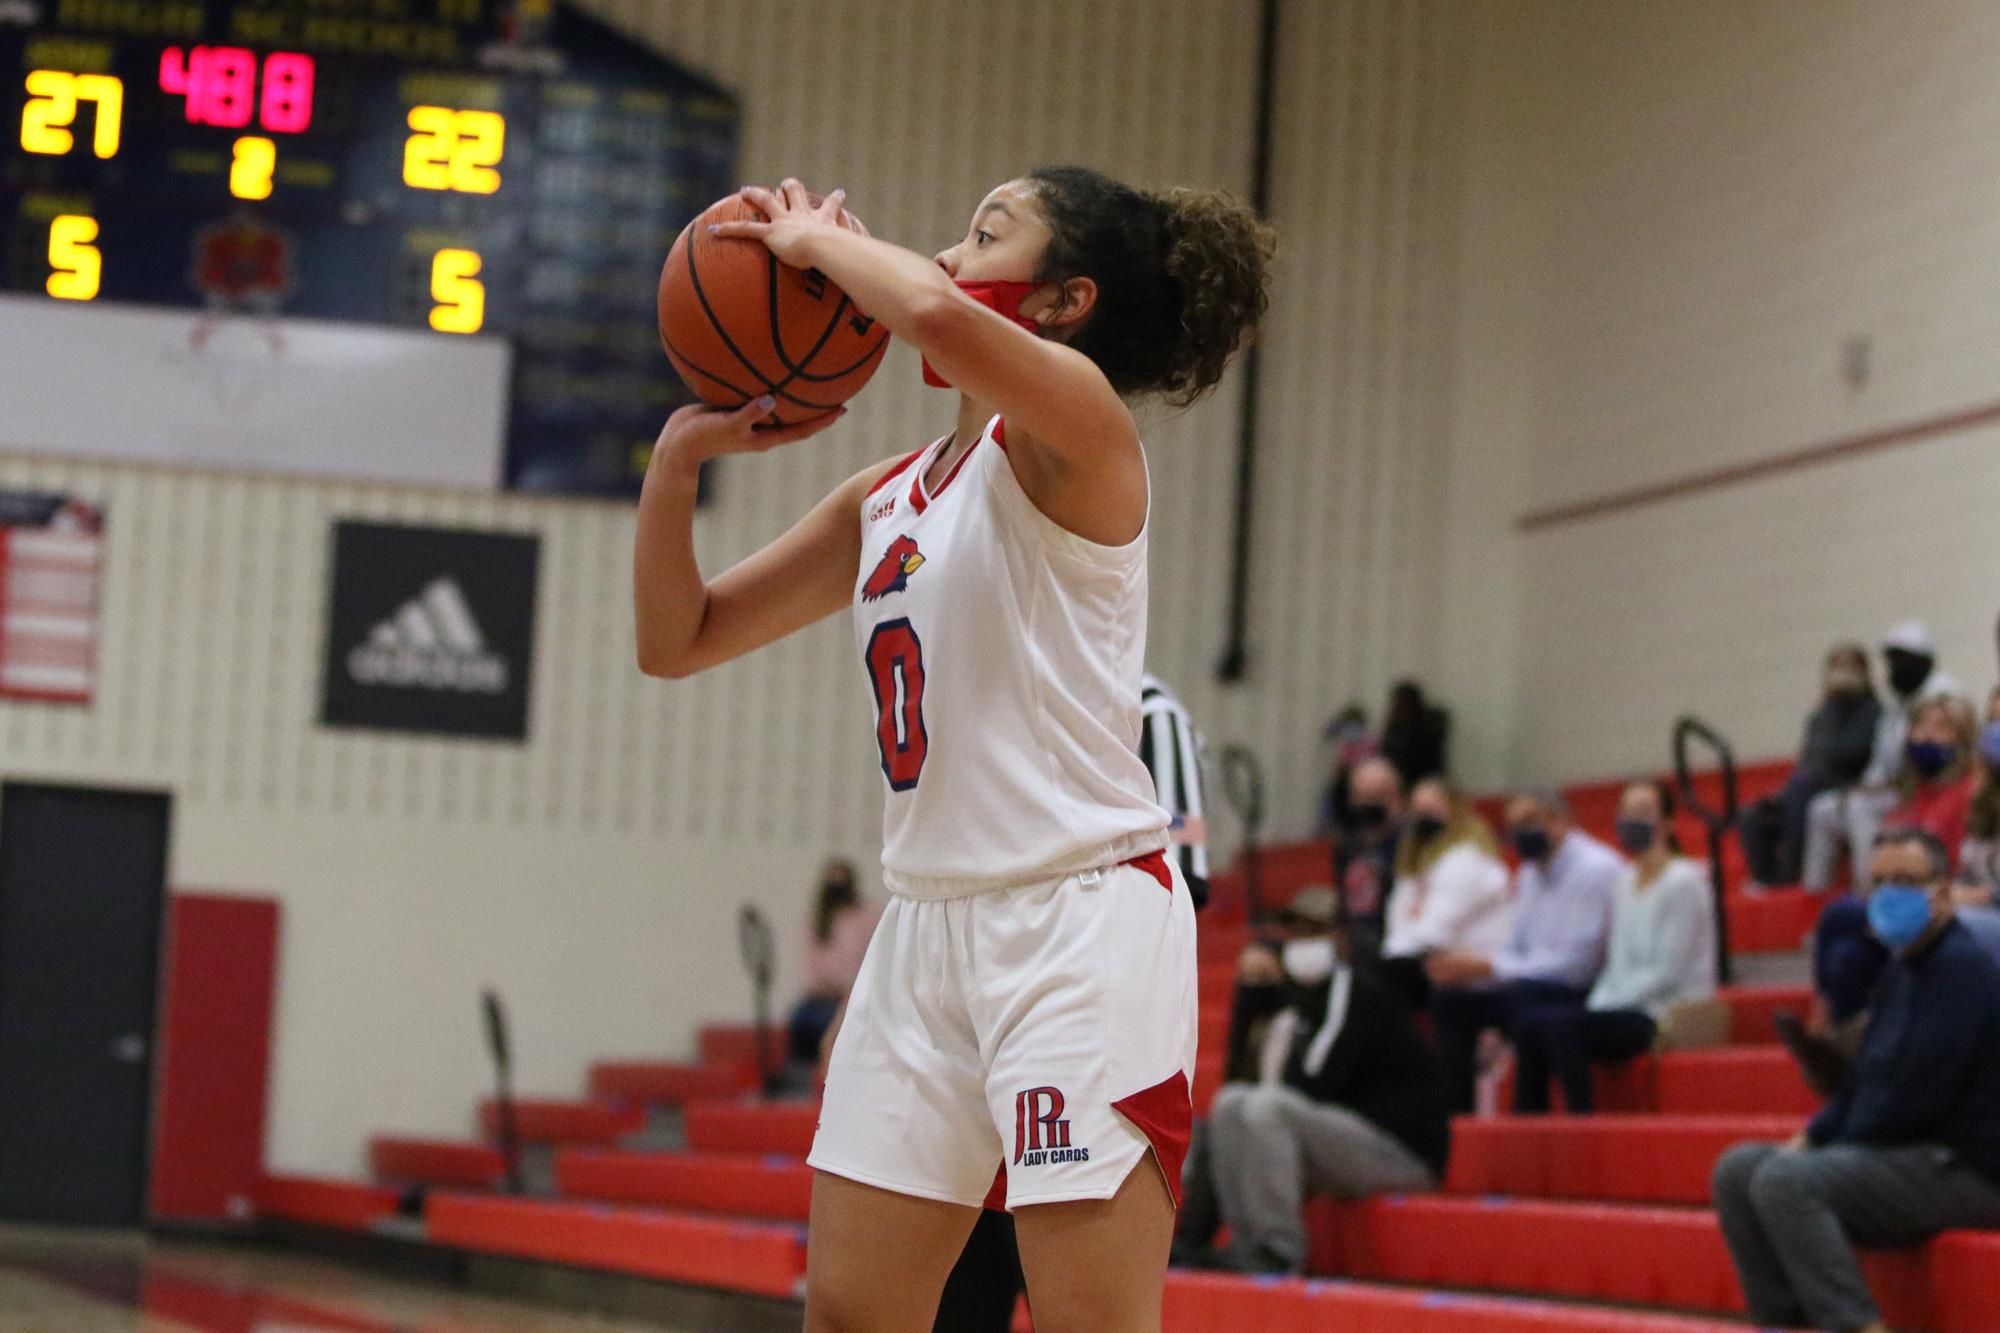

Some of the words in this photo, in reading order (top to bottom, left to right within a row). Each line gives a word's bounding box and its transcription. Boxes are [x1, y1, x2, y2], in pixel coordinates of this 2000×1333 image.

[21, 69, 123, 159] 27
[403, 105, 505, 195] 22
[47, 214, 102, 301] 5
[429, 248, 485, 334] 5
[865, 617, 929, 792] 0
[1023, 1151, 1048, 1167] LADY
[1050, 1147, 1090, 1164] CARDS
